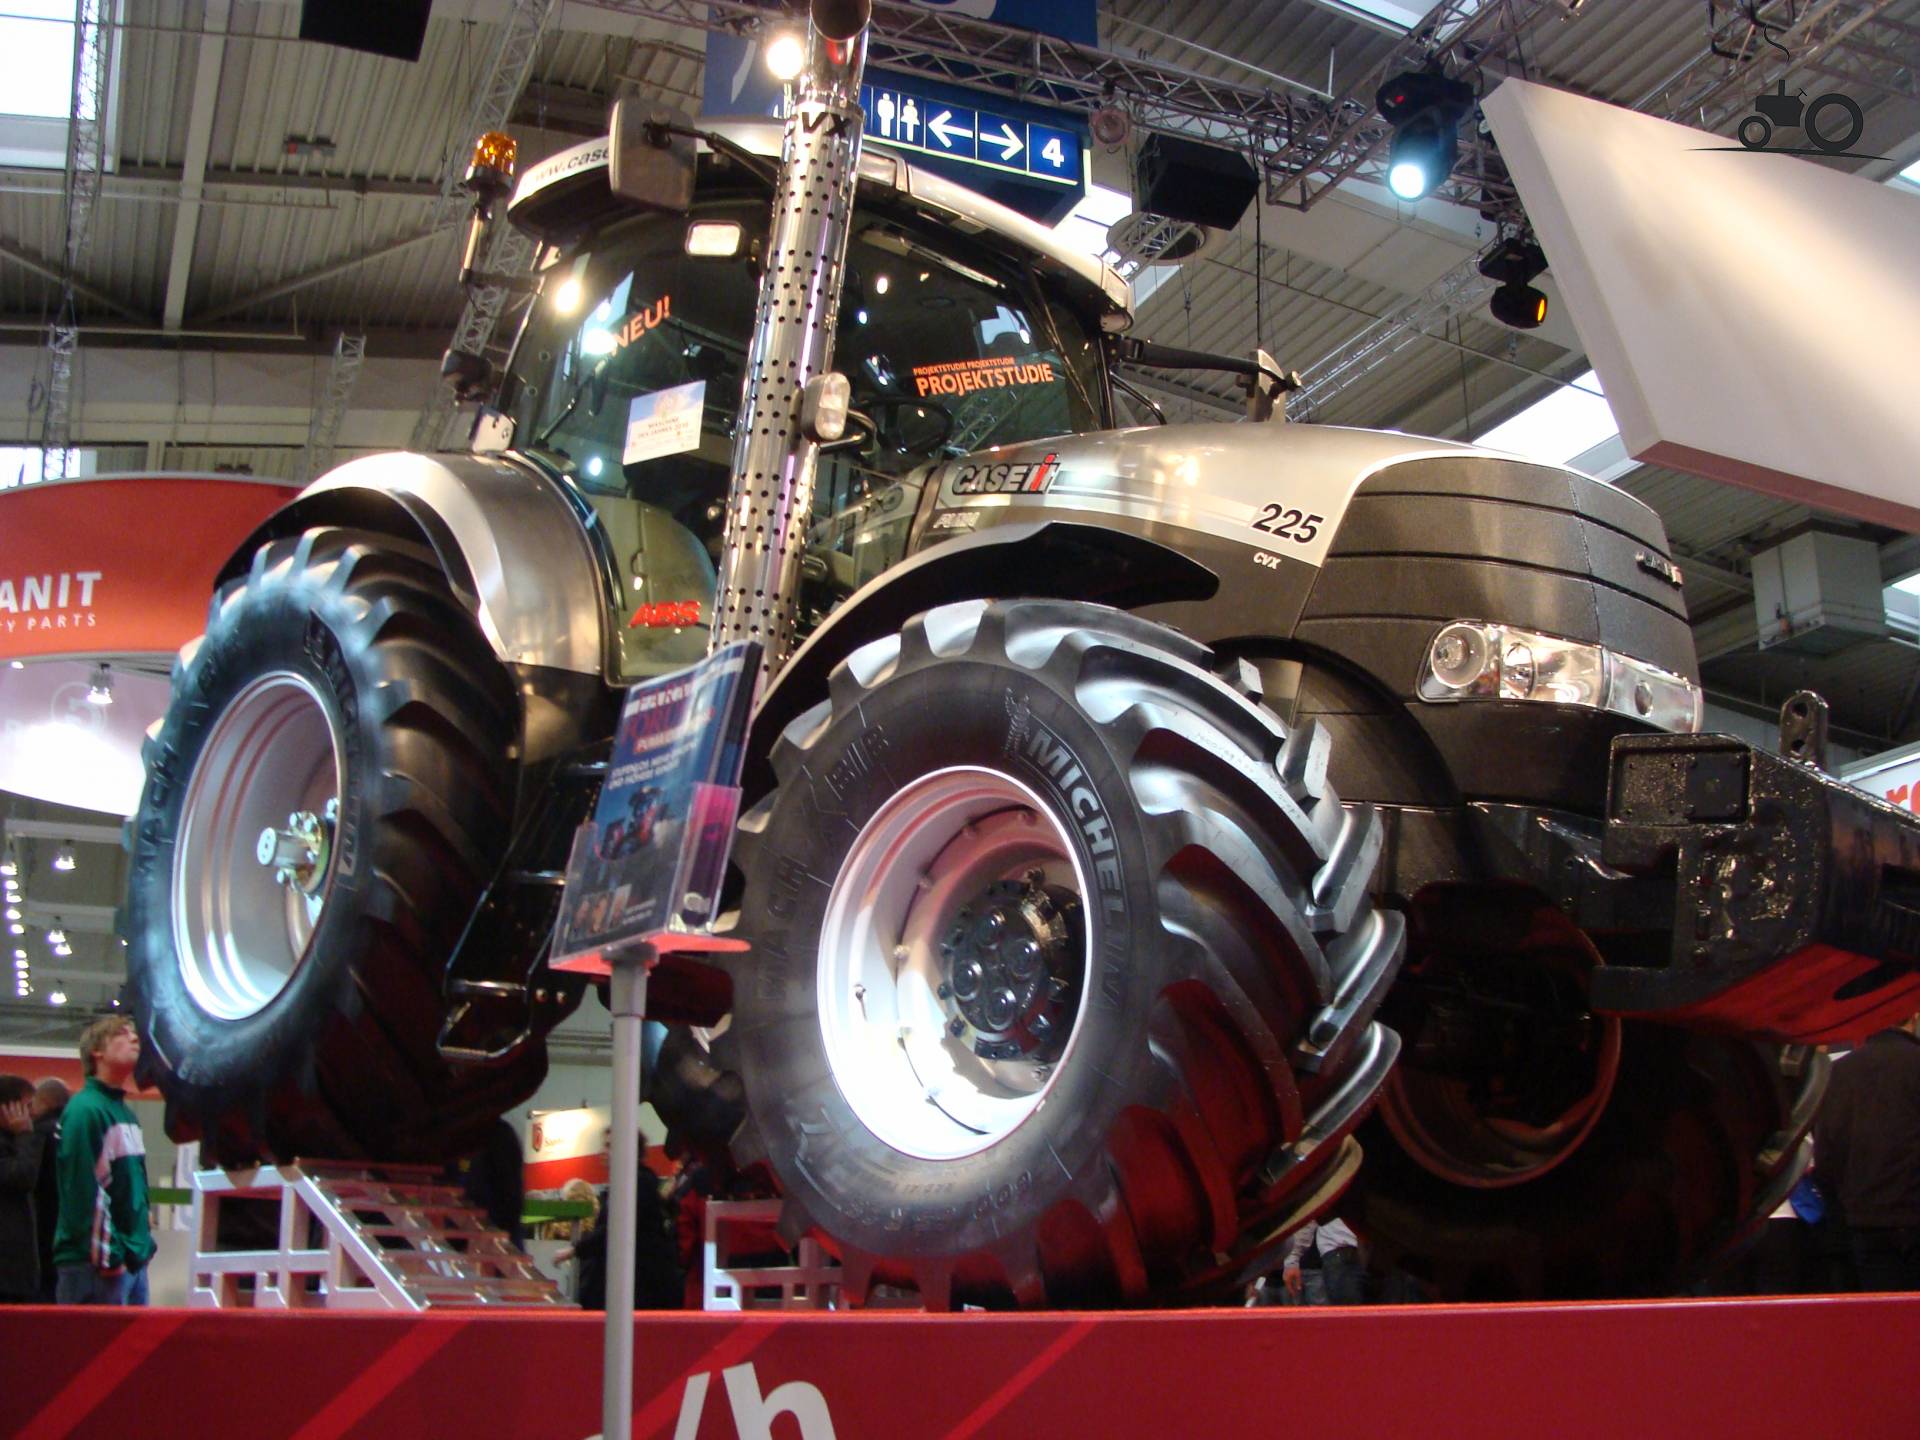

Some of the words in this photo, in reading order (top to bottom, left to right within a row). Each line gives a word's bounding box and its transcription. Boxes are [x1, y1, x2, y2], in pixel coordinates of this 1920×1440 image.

[1041, 138, 1065, 168] 4
[611, 295, 671, 358] NEU!
[916, 363, 1055, 397] PROJEKTSTUDIE
[1251, 502, 1325, 545] 225
[1253, 551, 1282, 570] CVX
[0, 571, 103, 614] ANIT
[27, 612, 97, 631] PARTS
[1027, 730, 1126, 1010] MICHELIN
